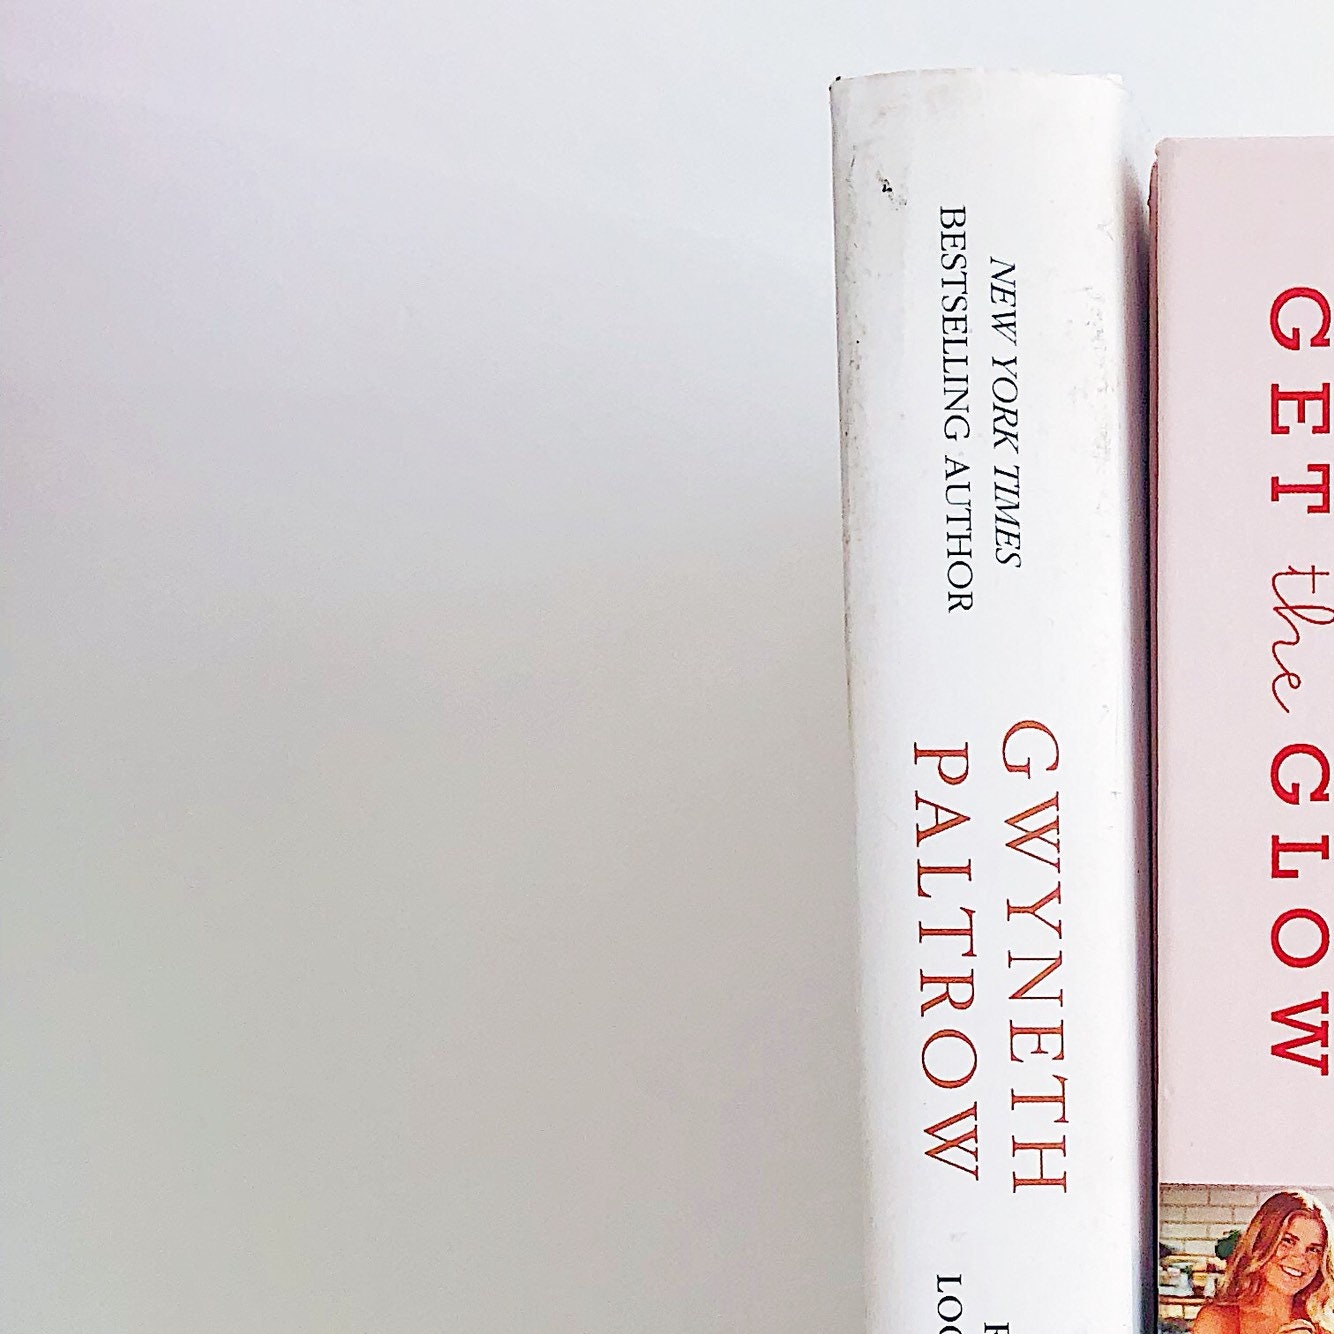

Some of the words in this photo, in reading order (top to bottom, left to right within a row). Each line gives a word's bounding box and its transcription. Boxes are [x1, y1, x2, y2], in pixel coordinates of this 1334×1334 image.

[939, 204, 971, 442] BESTSELLING
[989, 255, 1018, 347] NEW
[991, 355, 1019, 454] YORK
[1269, 286, 1332, 515] GET
[944, 454, 974, 614] AUTHOR
[993, 464, 1022, 569] TIMES
[913, 741, 980, 1182] PALTROW
[1001, 719, 1070, 1194] GWYNETH
[1269, 743, 1331, 1077] GLOW
